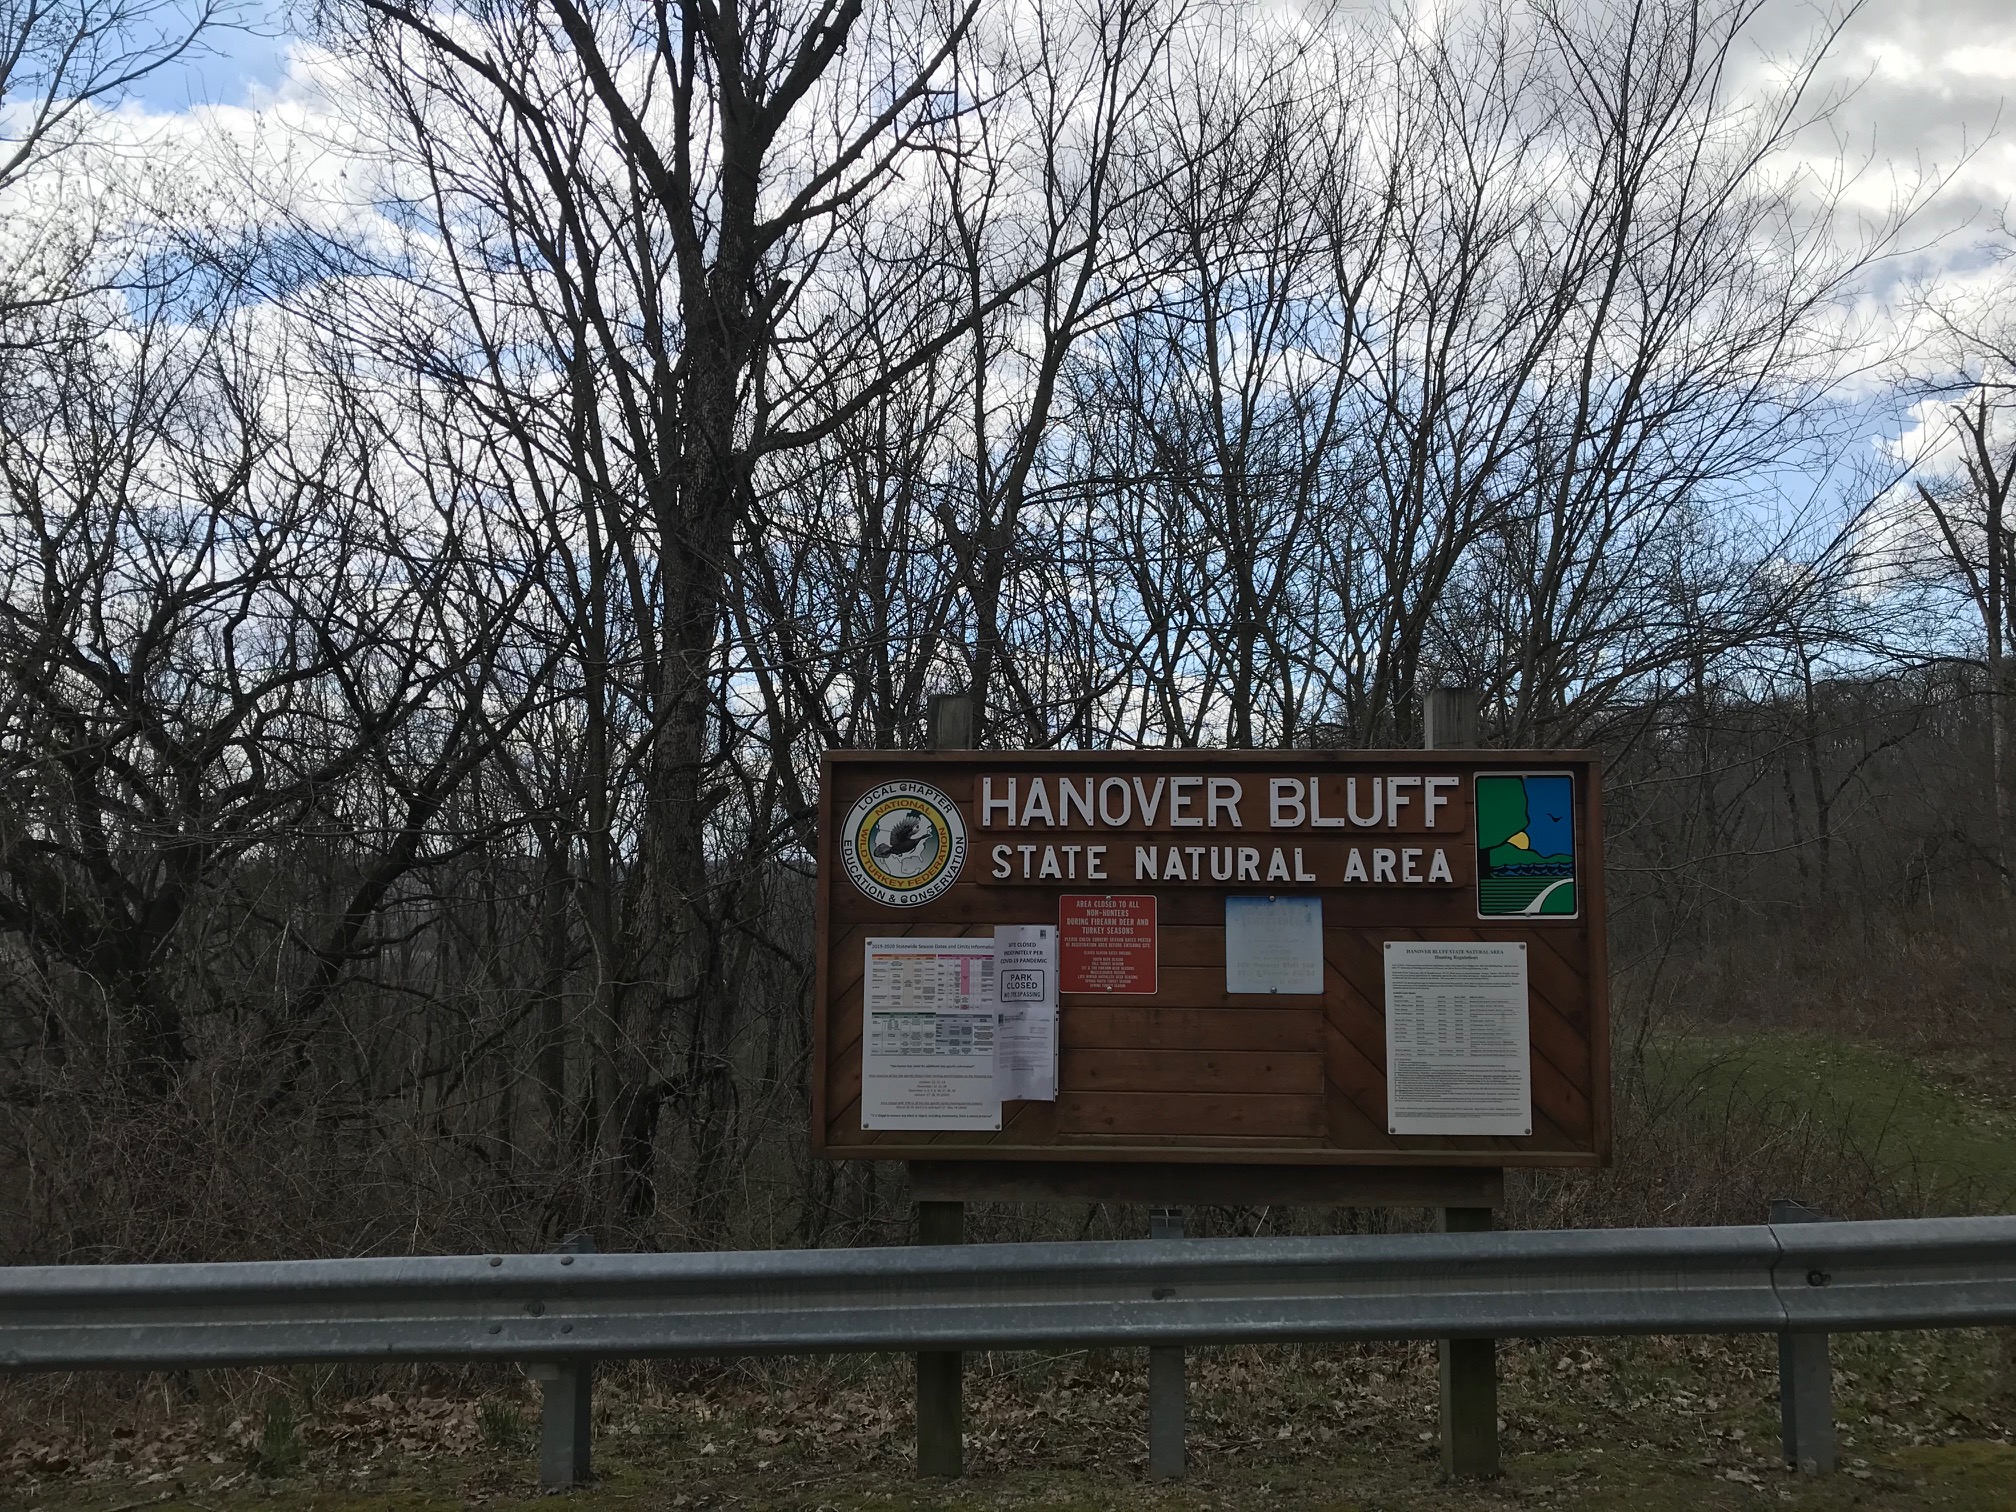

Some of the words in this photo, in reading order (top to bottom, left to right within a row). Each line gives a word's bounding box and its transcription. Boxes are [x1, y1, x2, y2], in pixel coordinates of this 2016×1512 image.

[858, 785, 896, 811] LOCAL
[900, 783, 952, 814] CHAPTER
[875, 800, 931, 816] NATIONAL
[982, 776, 1243, 828] HANOVER
[1270, 776, 1460, 828] BLUFF
[844, 840, 886, 899] EDUCATION
[889, 894, 896, 903] &
[900, 837, 964, 904] CONSERVATION
[860, 828, 869, 858] WILD
[865, 859, 904, 887] TURKEY
[908, 828, 948, 887] FEDERATION
[991, 844, 1107, 880] STATE
[1135, 845, 1316, 882] NATURAL
[1344, 848, 1453, 883] AREA
